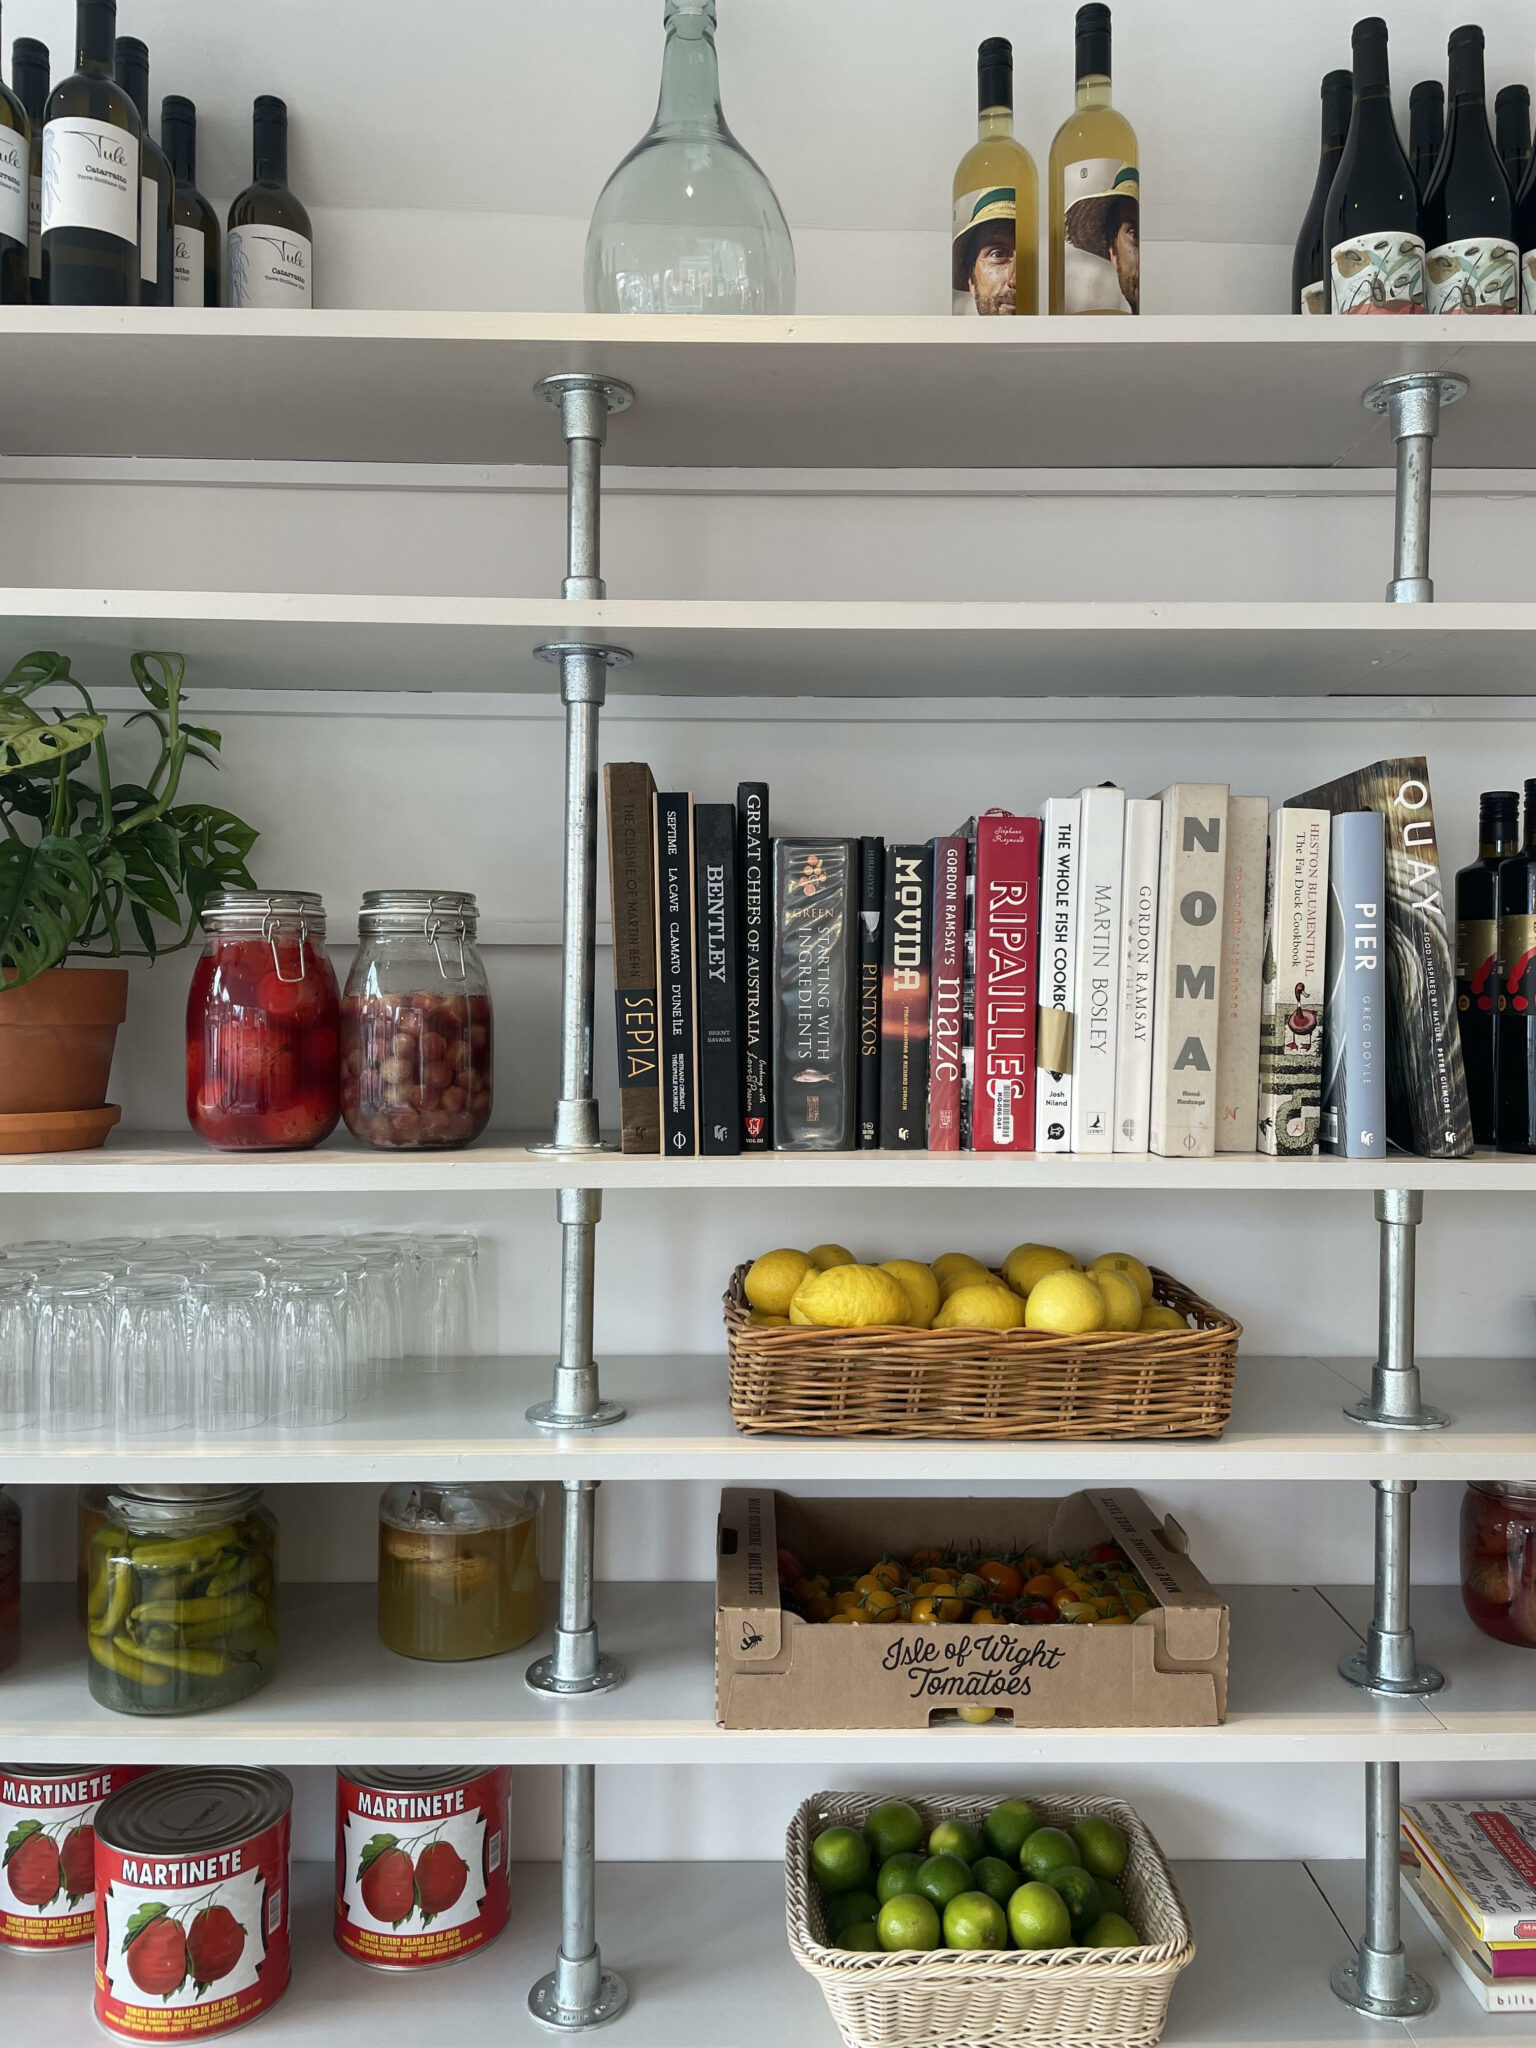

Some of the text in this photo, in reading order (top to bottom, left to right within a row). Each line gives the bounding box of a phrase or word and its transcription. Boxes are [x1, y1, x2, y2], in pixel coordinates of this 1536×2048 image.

[0, 138, 21, 169] ule
[64, 131, 127, 166] Tule
[251, 236, 305, 268] Tule
[624, 804, 641, 977] THE CUISINE OF MARTIN BENN
[1393, 780, 1442, 915] QUAY
[666, 811, 684, 1036] SEPTIME LA CAVE CLAMATO D'UNE ÎLE
[707, 865, 726, 984] BENTLEY
[746, 794, 761, 1046] GREAT CHEFS OF AUSTRALIA
[793, 908, 834, 918] GREEN
[893, 857, 923, 992] MOVIDA
[945, 849, 958, 965] GORDON RAMSAY'S
[1053, 824, 1071, 1012] THE WHOLE FISH COOKBO
[1173, 817, 1220, 1072] NOMA
[1291, 832, 1306, 967] The Fat Duck Cookbook
[1305, 823, 1320, 977] HESTON BLUMENTHAL
[1354, 903, 1377, 971] PIER
[799, 928, 812, 1059] INGREDIENTS
[817, 927, 830, 1060] STARTING WITH
[862, 963, 877, 1056] PINTXOS
[986, 881, 1028, 1099] RIPAILLES
[1090, 884, 1112, 1054] MARTIN BOSLEY
[1134, 886, 1151, 1042] GORDON RAMSAY
[625, 998, 656, 1078] SEPIA
[935, 976, 960, 1082] maze
[1362, 996, 1372, 1085] GREG DOYLE
[1424, 932, 1451, 1114] FOOD INSPIRED BY NATURE PETER GILMORE
[1045, 1099, 1067, 1107] Niland
[749, 1573, 763, 1595] TASTE
[882, 1634, 1066, 1676] Isle of Wight
[908, 1667, 1032, 1698] Tomatoes
[2, 1774, 112, 1805] MARTINETE
[357, 1789, 465, 1819] MARTINETE
[122, 1849, 242, 1886] MARTINETE
[49, 1918, 71, 1927] PELADO
[402, 1935, 424, 1945] PELADO
[149, 2009, 172, 2019] ENTERO
[174, 2008, 198, 2019] PELADO
[201, 2006, 209, 2015] EN
[211, 2002, 220, 2012] SU
[221, 1996, 238, 2009] JUGO
